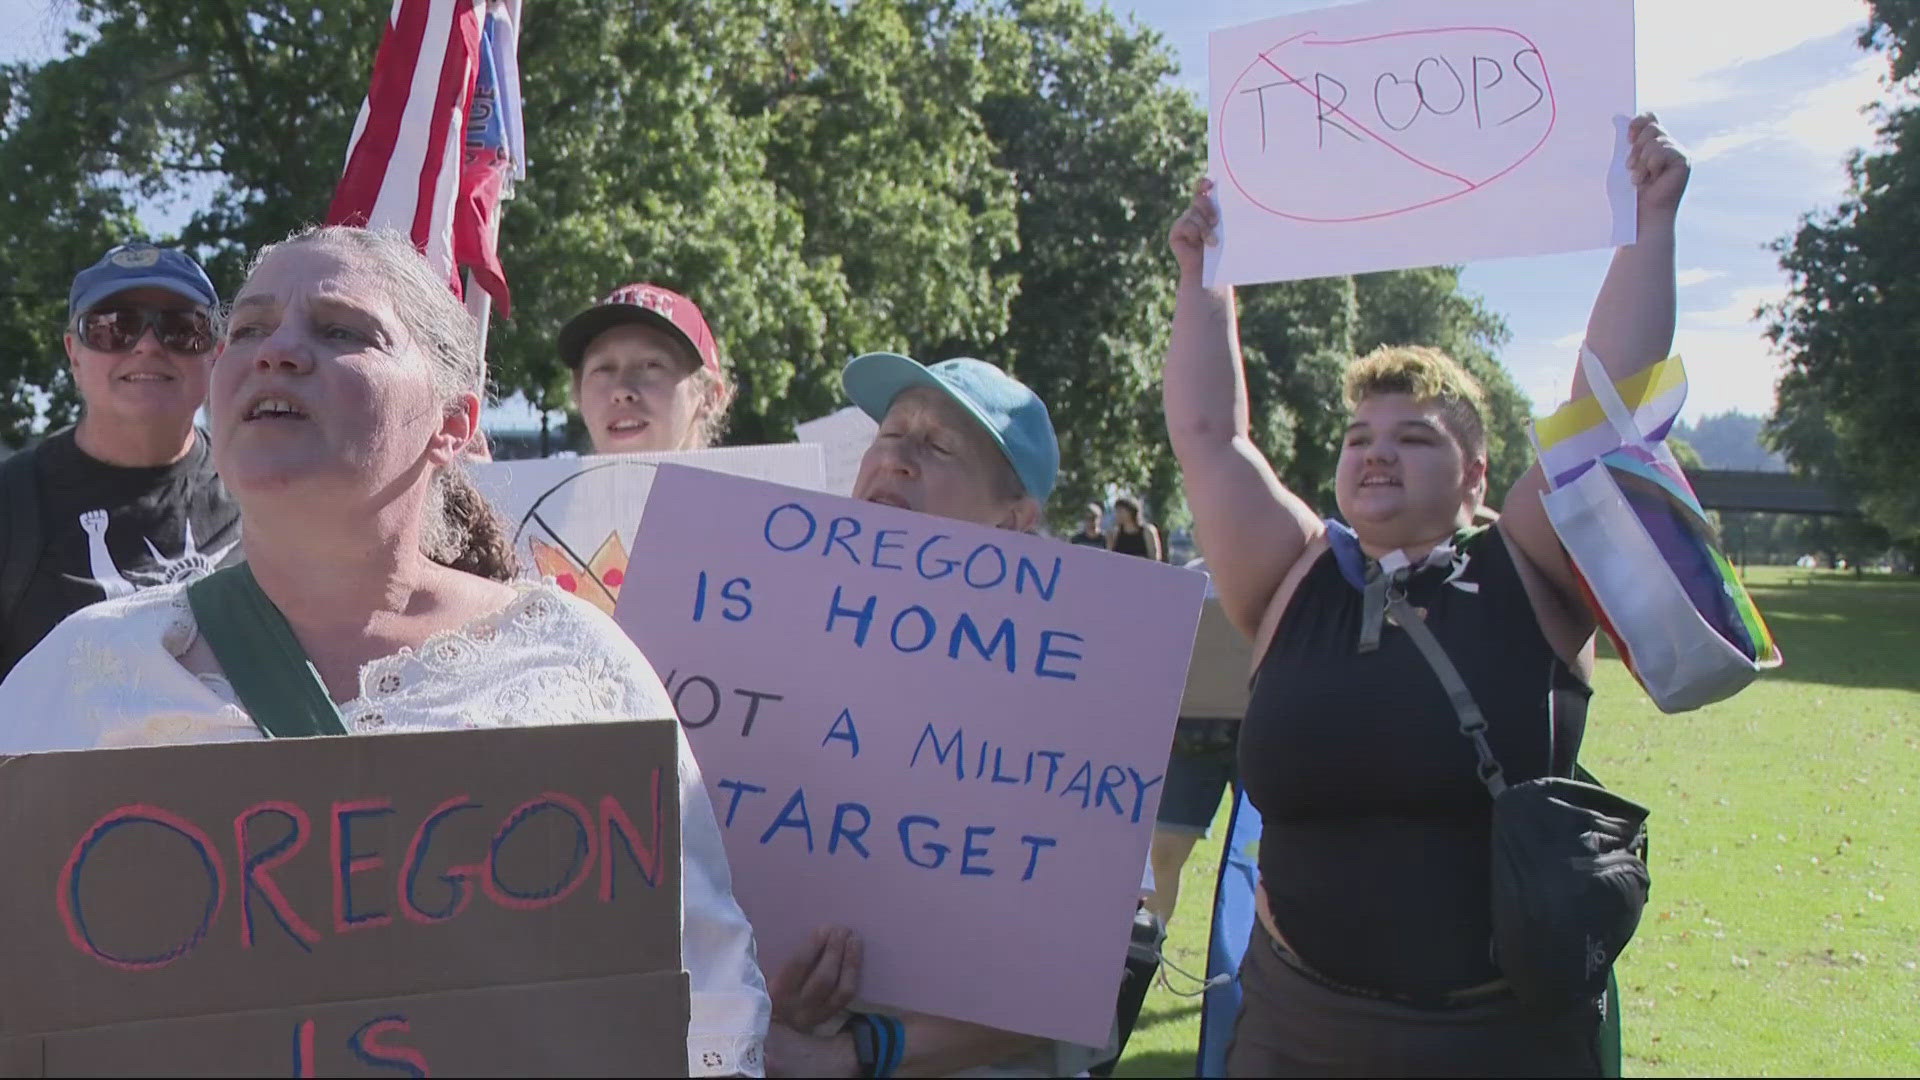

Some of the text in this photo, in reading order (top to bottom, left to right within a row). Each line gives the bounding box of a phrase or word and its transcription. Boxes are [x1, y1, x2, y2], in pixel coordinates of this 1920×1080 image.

[1240, 48, 1543, 152] TROOPS
[763, 503, 1062, 601] OREGON
[692, 571, 1084, 680] IS HOME
[822, 707, 860, 758] A
[910, 722, 1163, 823] MILITARY
[56, 768, 662, 970] OREGON
[718, 780, 1057, 881] TARGET
[292, 1012, 431, 1078] IS
